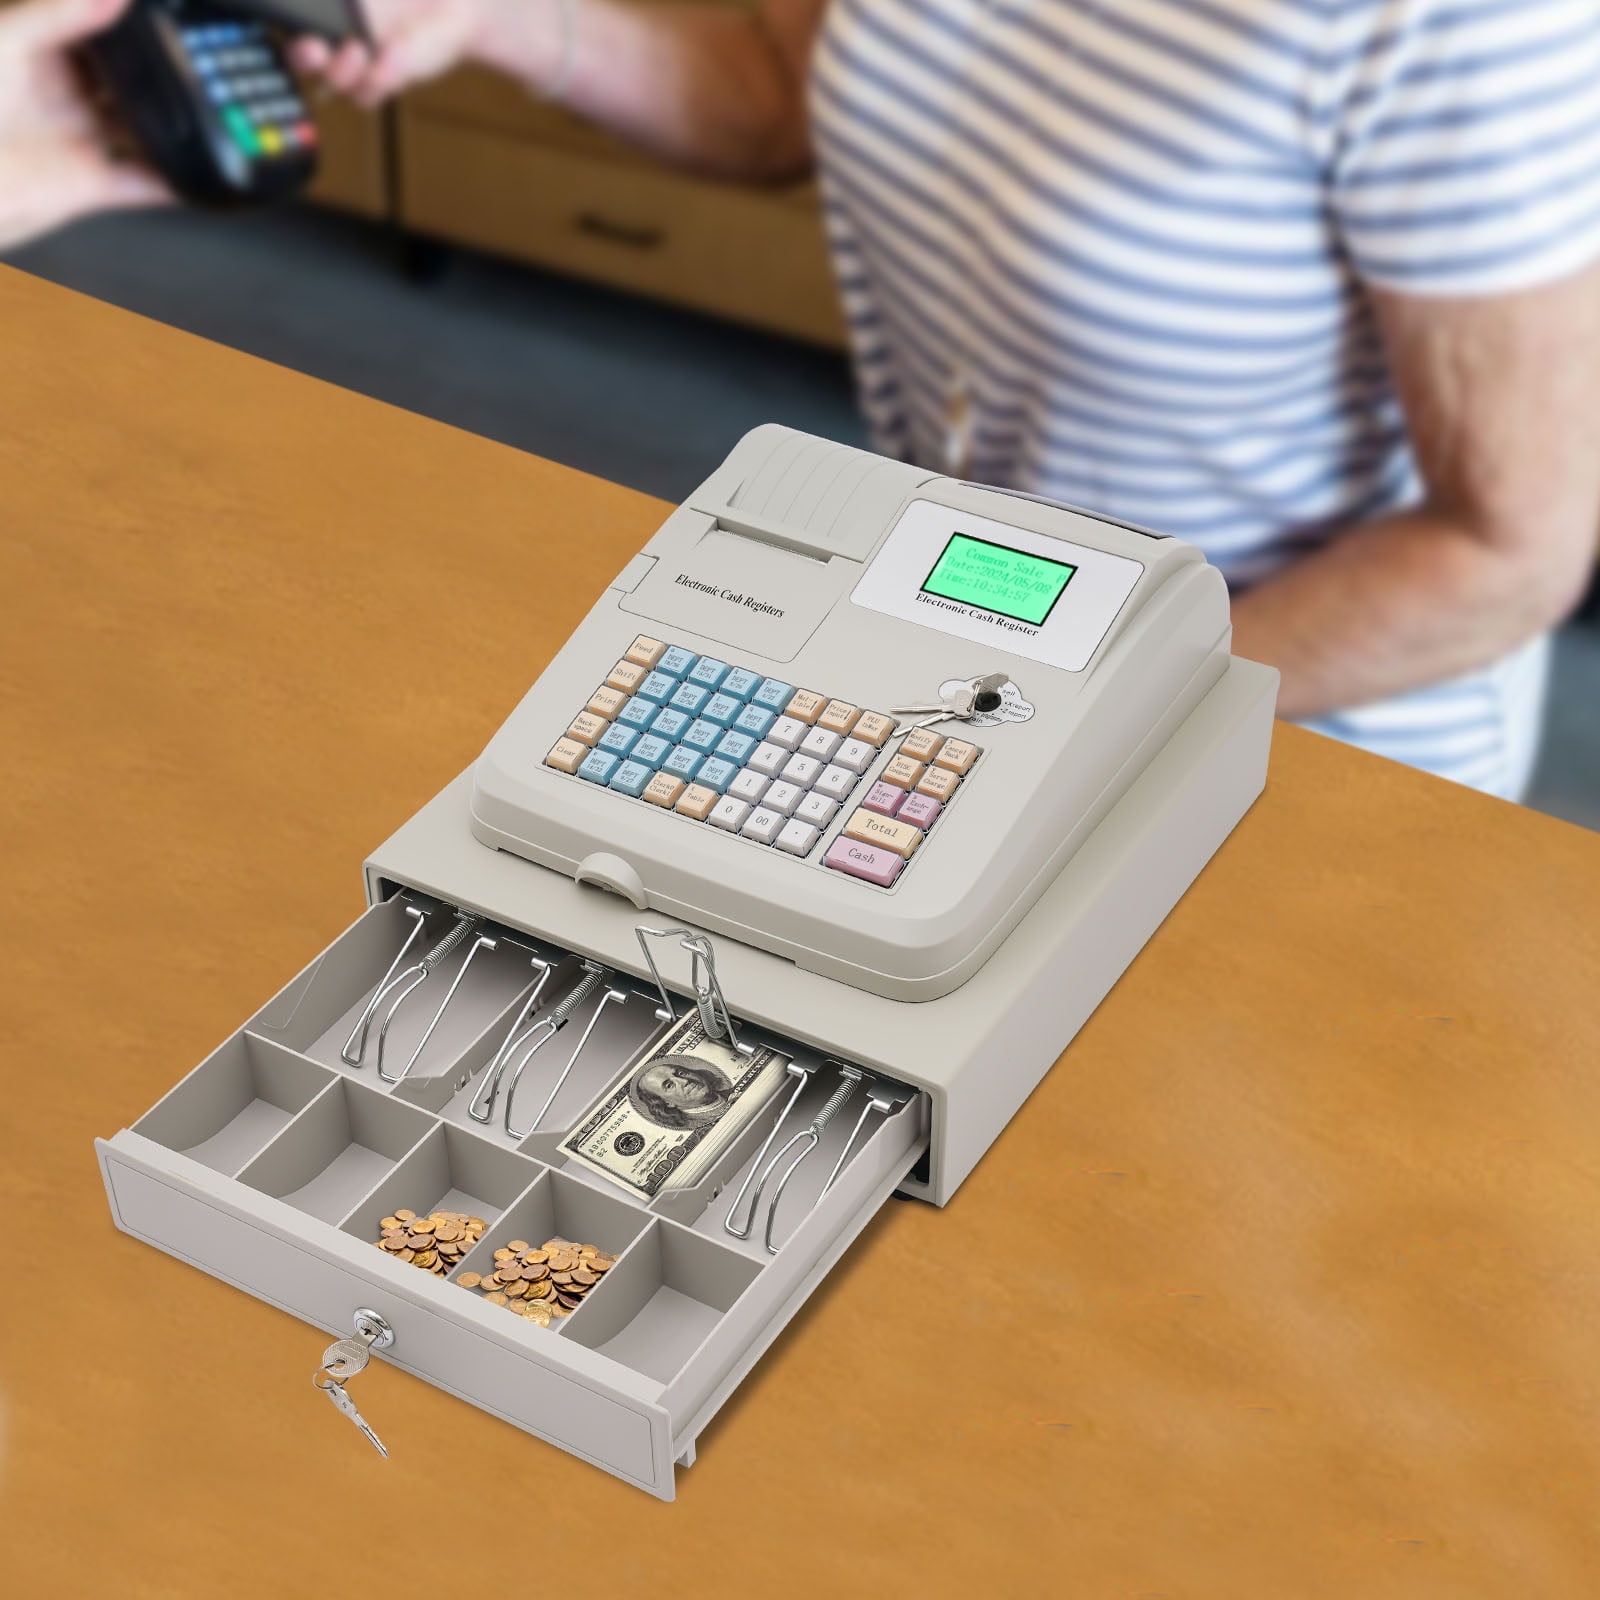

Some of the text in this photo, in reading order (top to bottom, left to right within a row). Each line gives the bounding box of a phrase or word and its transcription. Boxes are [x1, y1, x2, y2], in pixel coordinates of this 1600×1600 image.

[966, 547, 1009, 568] Common
[1014, 561, 1044, 577] Sale
[675, 573, 785, 618] Electronic Cash Registers
[915, 592, 1039, 637] Electronic Cash Register
[595, 694, 617, 706] Print
[784, 725, 792, 733] 7
[816, 736, 824, 745] 8
[850, 747, 858, 755] 9
[764, 752, 773, 760] 4
[797, 763, 806, 771] 5
[745, 778, 752, 787] 1
[831, 774, 840, 783] 6
[777, 789, 786, 798] 2
[812, 801, 820, 810] 3
[755, 815, 769, 826] 00
[865, 818, 898, 838] Total
[848, 847, 875, 864] Cash
